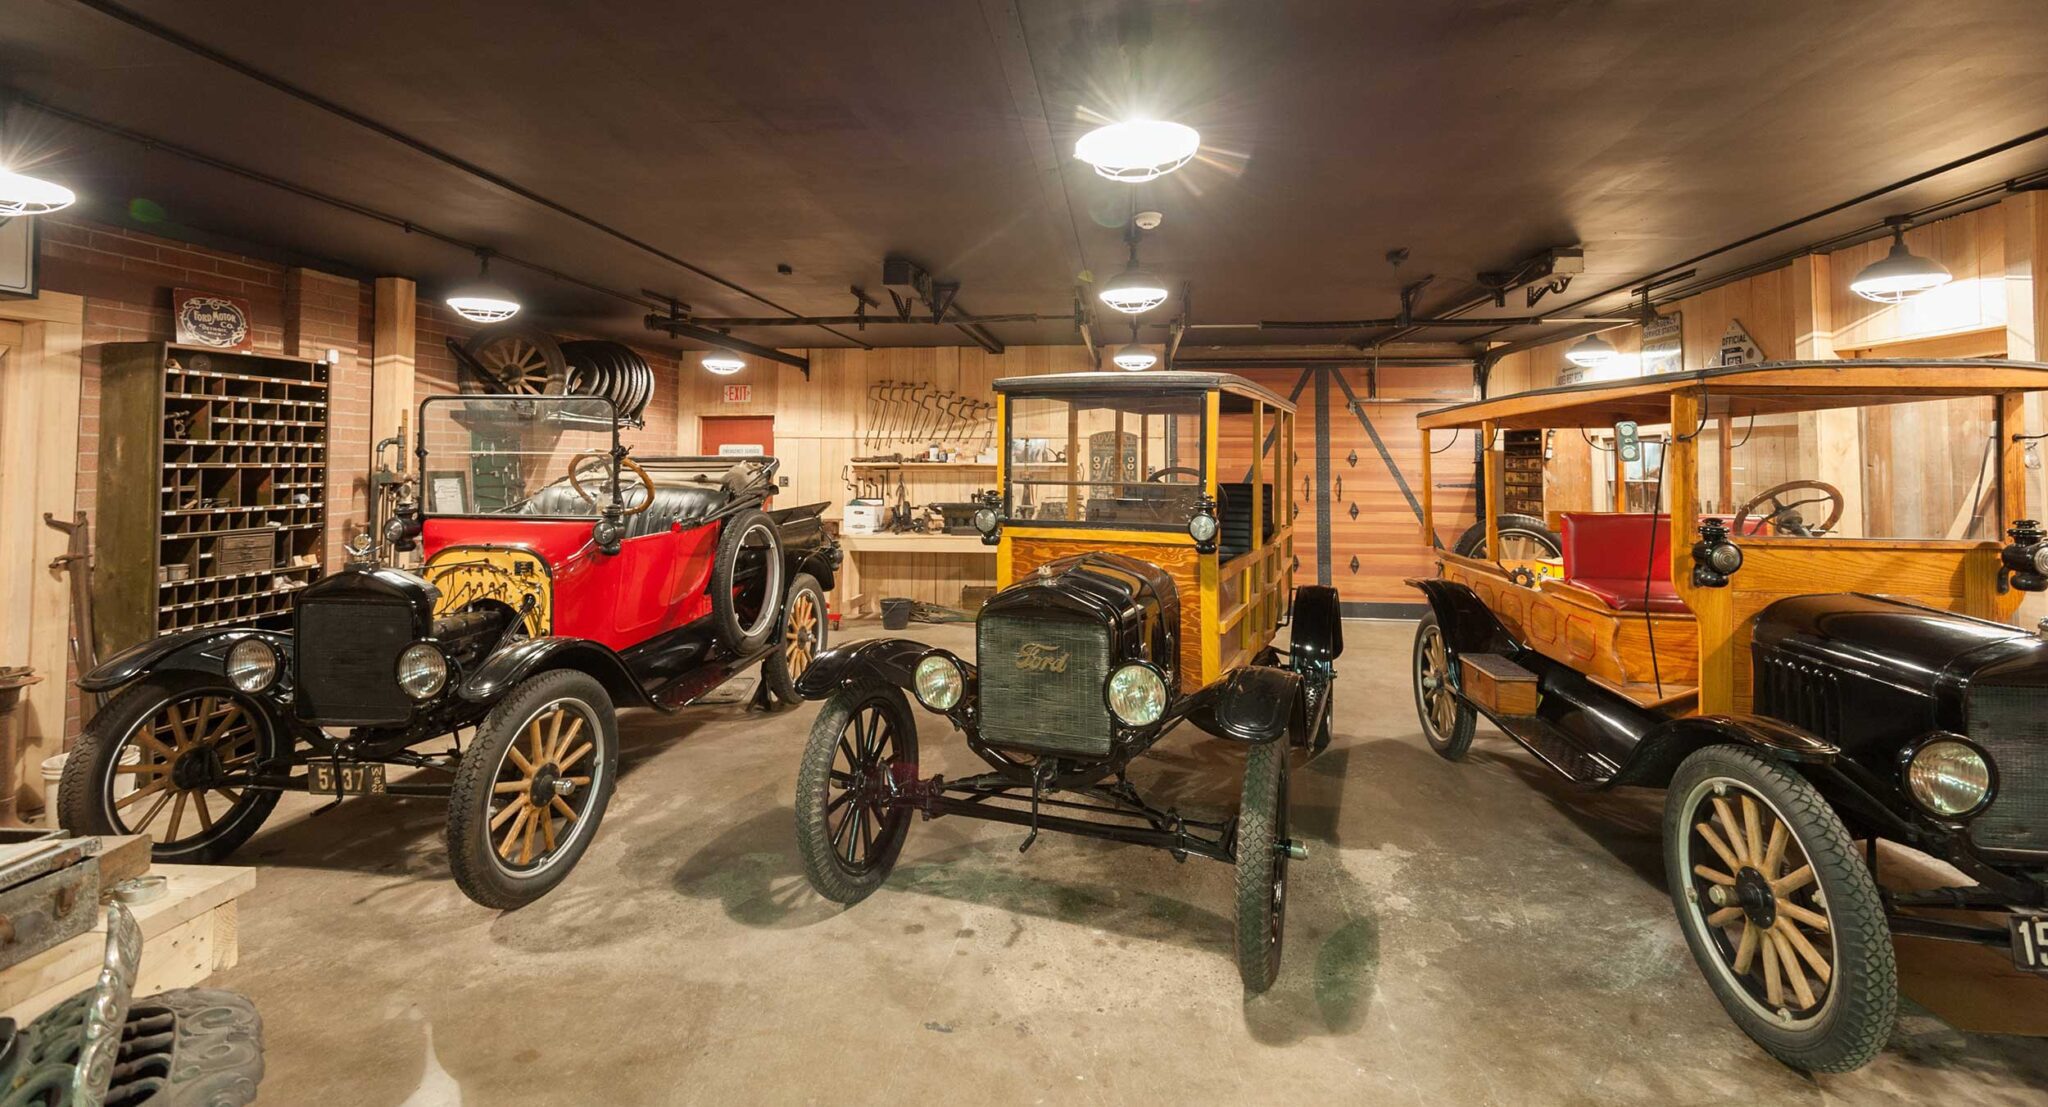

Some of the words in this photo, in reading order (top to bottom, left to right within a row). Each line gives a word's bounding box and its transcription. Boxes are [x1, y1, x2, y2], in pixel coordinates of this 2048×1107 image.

[211, 311, 236, 324] MOTOR
[1721, 334, 1747, 346] OFFICIAL
[729, 386, 748, 401] EXIT
[1016, 643, 1072, 673] Ford
[2018, 921, 2048, 967] 15
